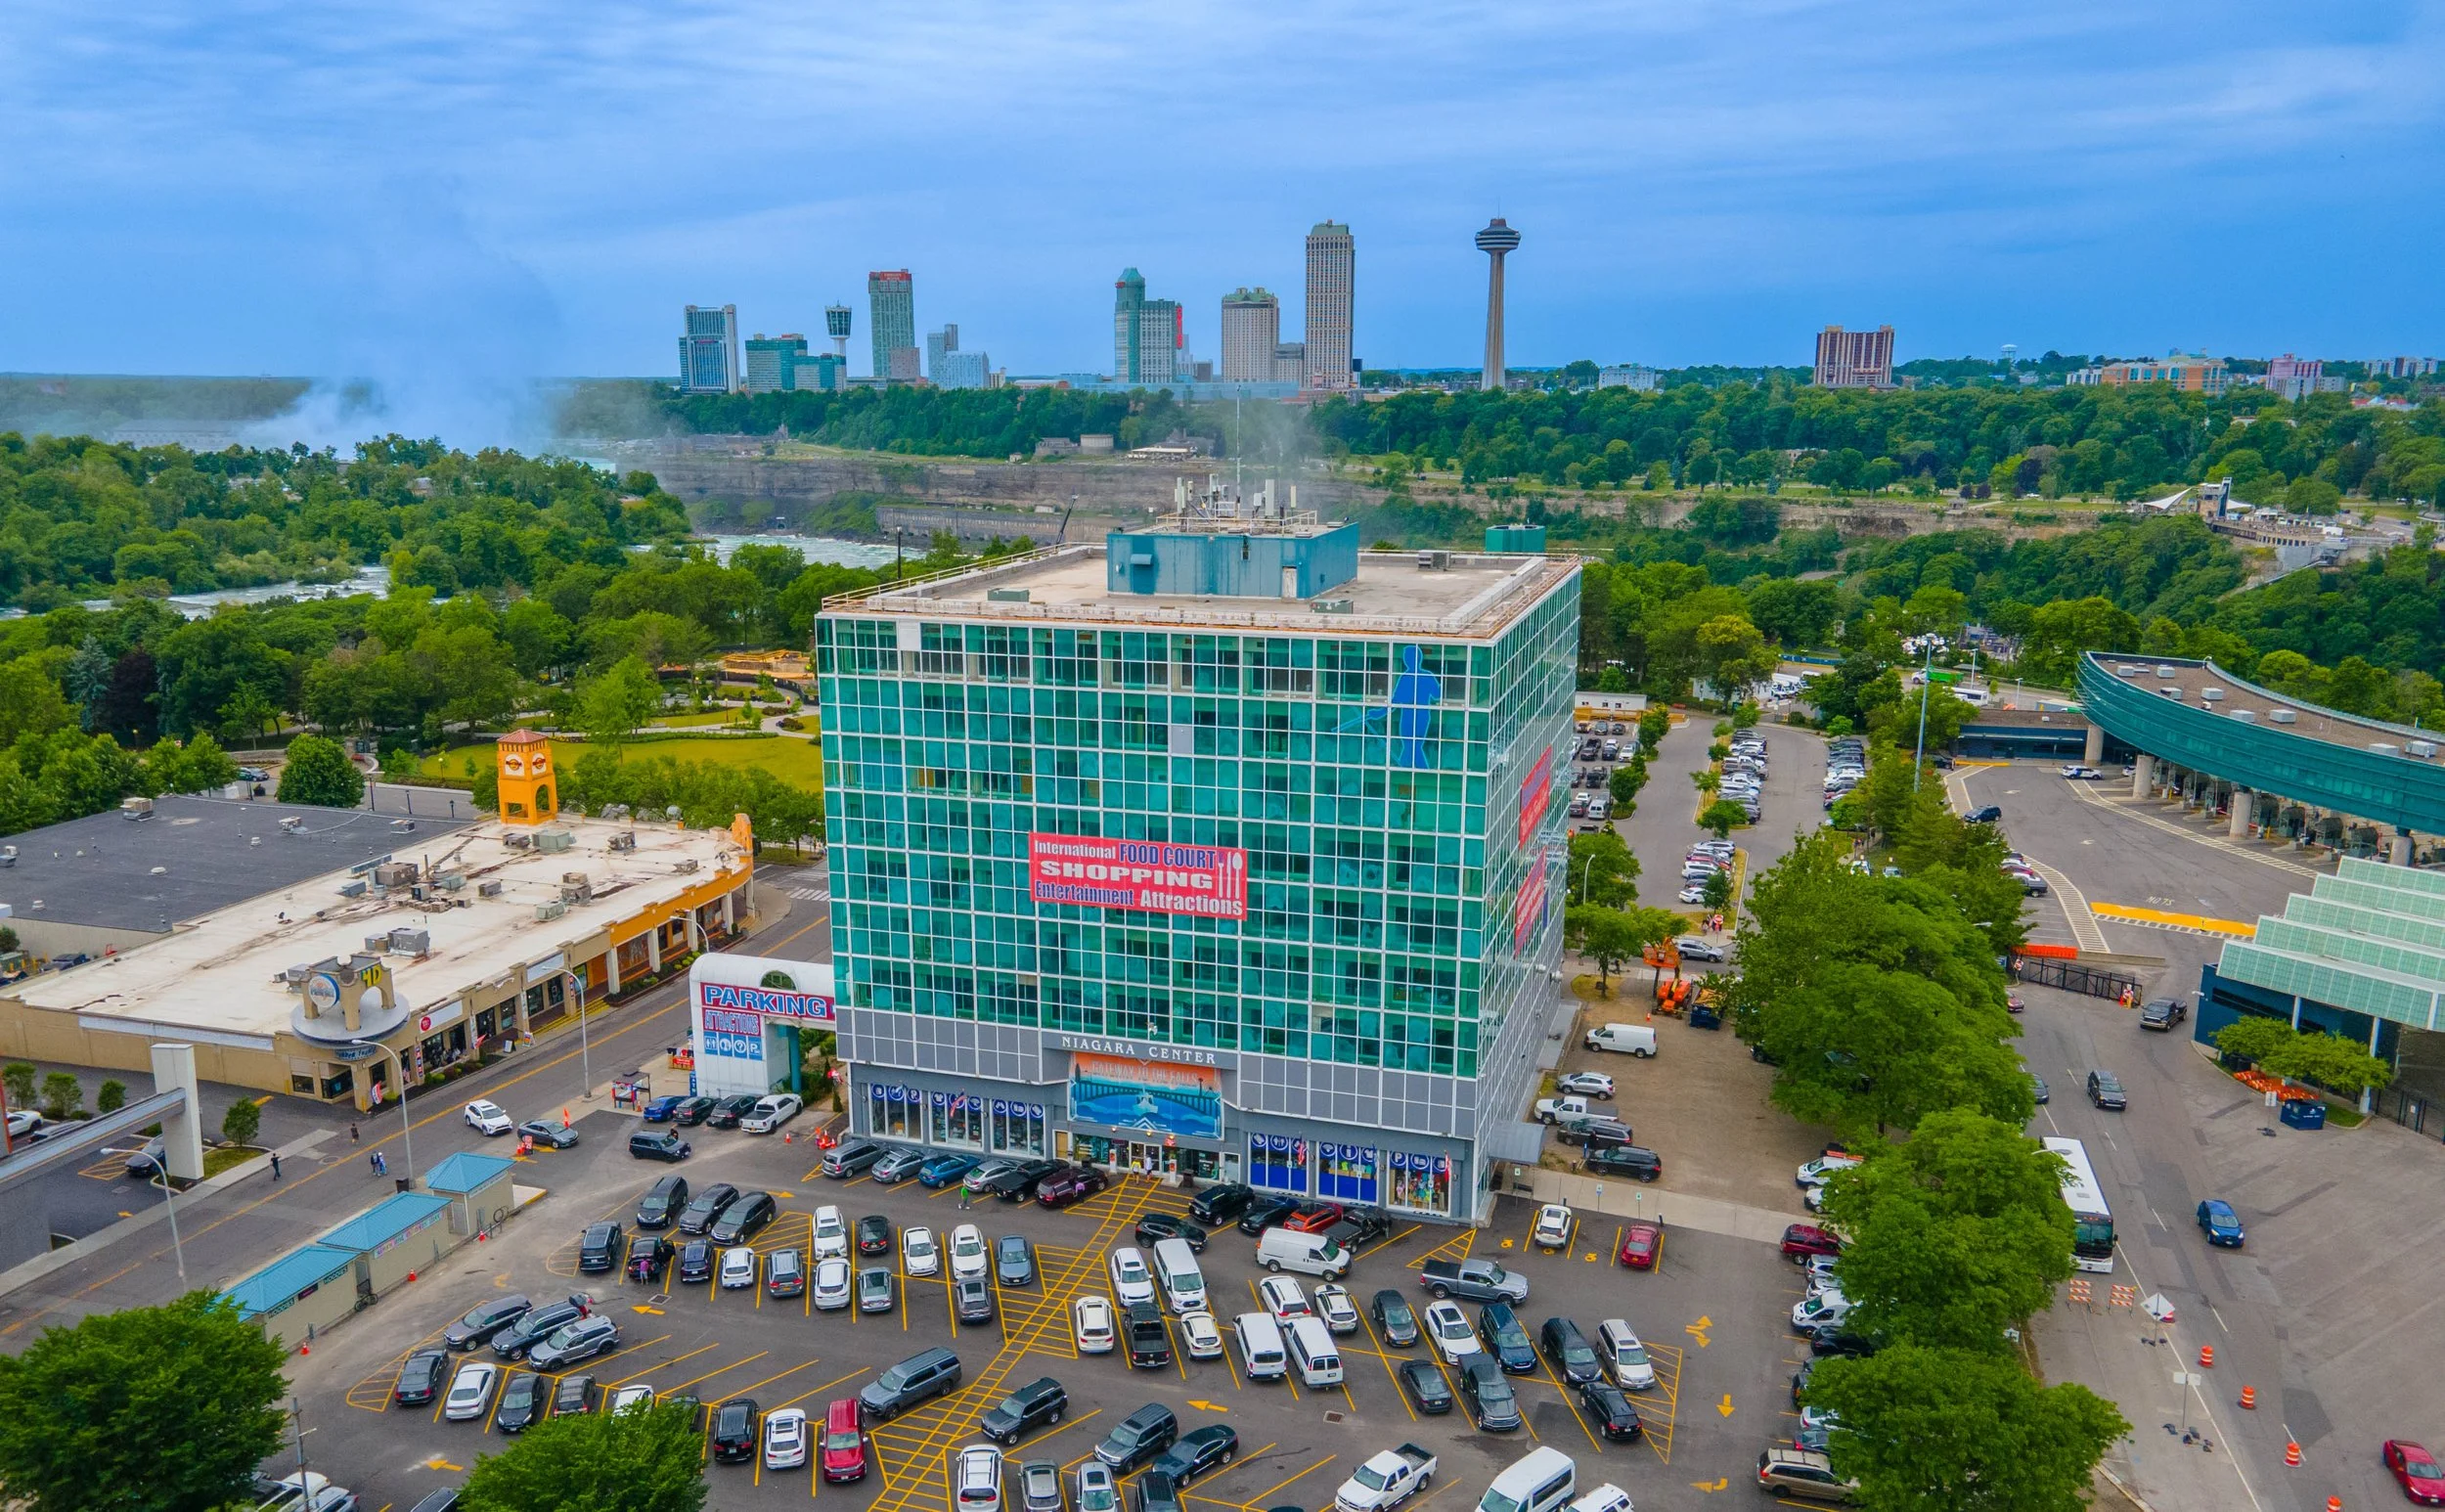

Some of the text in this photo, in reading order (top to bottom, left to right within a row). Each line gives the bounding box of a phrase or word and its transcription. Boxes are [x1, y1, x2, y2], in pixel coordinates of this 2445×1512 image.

[1034, 839, 1216, 869] International FOOD COURT
[1040, 861, 1213, 890] SHOPPING
[1035, 880, 1243, 915] Entertainment Attractions
[704, 985, 826, 1018] PARKING
[705, 1009, 760, 1035] ATTRACTIONS
[1062, 1036, 1217, 1065] NIAGARA CENTER
